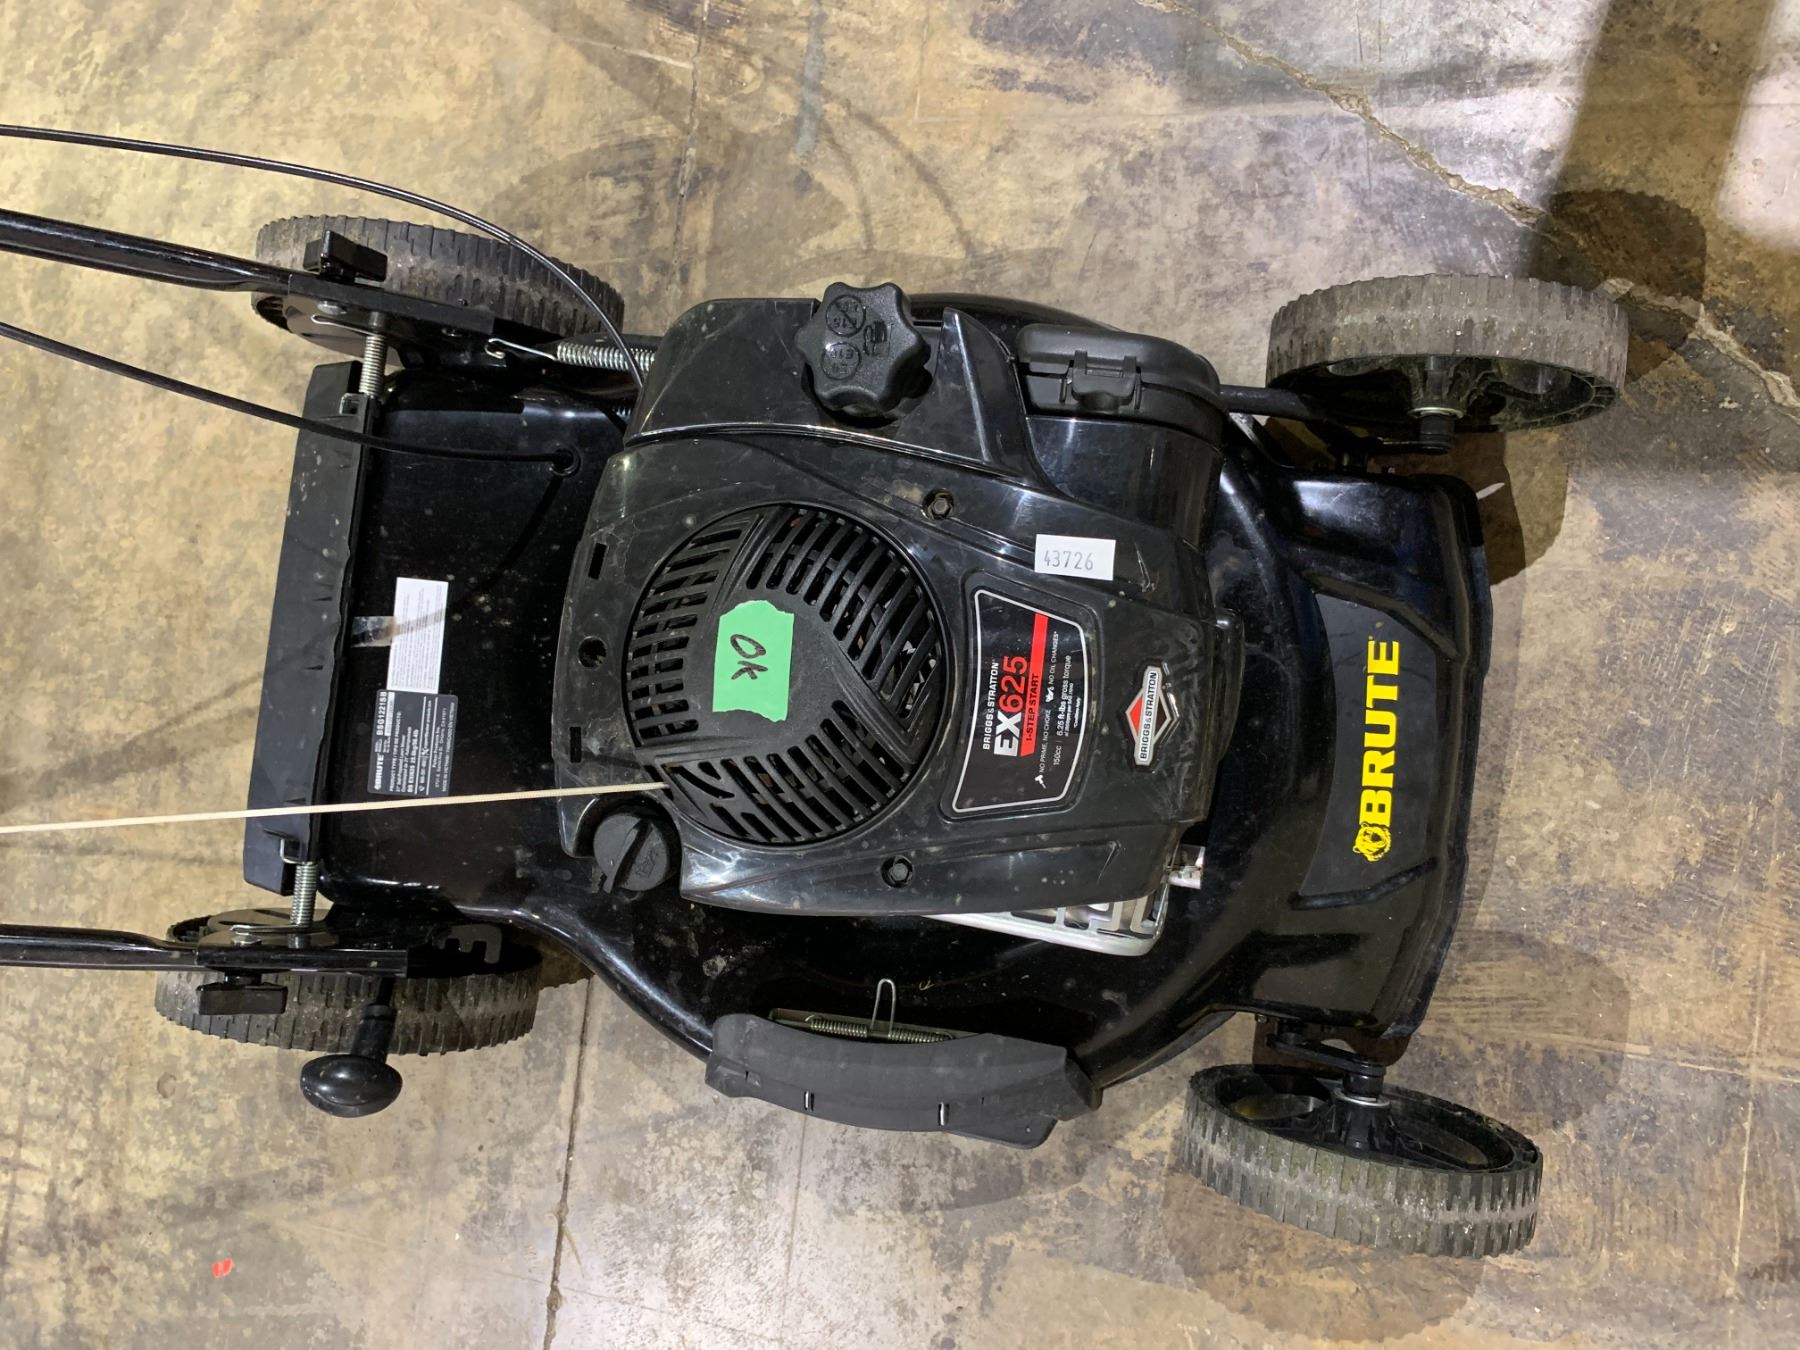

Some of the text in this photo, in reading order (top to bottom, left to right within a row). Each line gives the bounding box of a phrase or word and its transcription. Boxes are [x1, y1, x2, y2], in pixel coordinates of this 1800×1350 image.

[1044, 550, 1093, 570] 43726
[729, 634, 768, 680] OK
[1063, 655, 1072, 679] torque
[1027, 673, 1039, 706] START
[1048, 674, 1055, 685] NO
[1061, 680, 1071, 700] gross
[994, 656, 1028, 757] EX625
[1042, 709, 1051, 731] CHOKE
[1057, 720, 1065, 736] 6.25
[1041, 731, 1048, 741] NO
[1359, 640, 1400, 828] BRUTE
[1053, 745, 1062, 765] 150cc
[374, 754, 385, 784] BRUTE
[1039, 763, 1046, 773] NO
